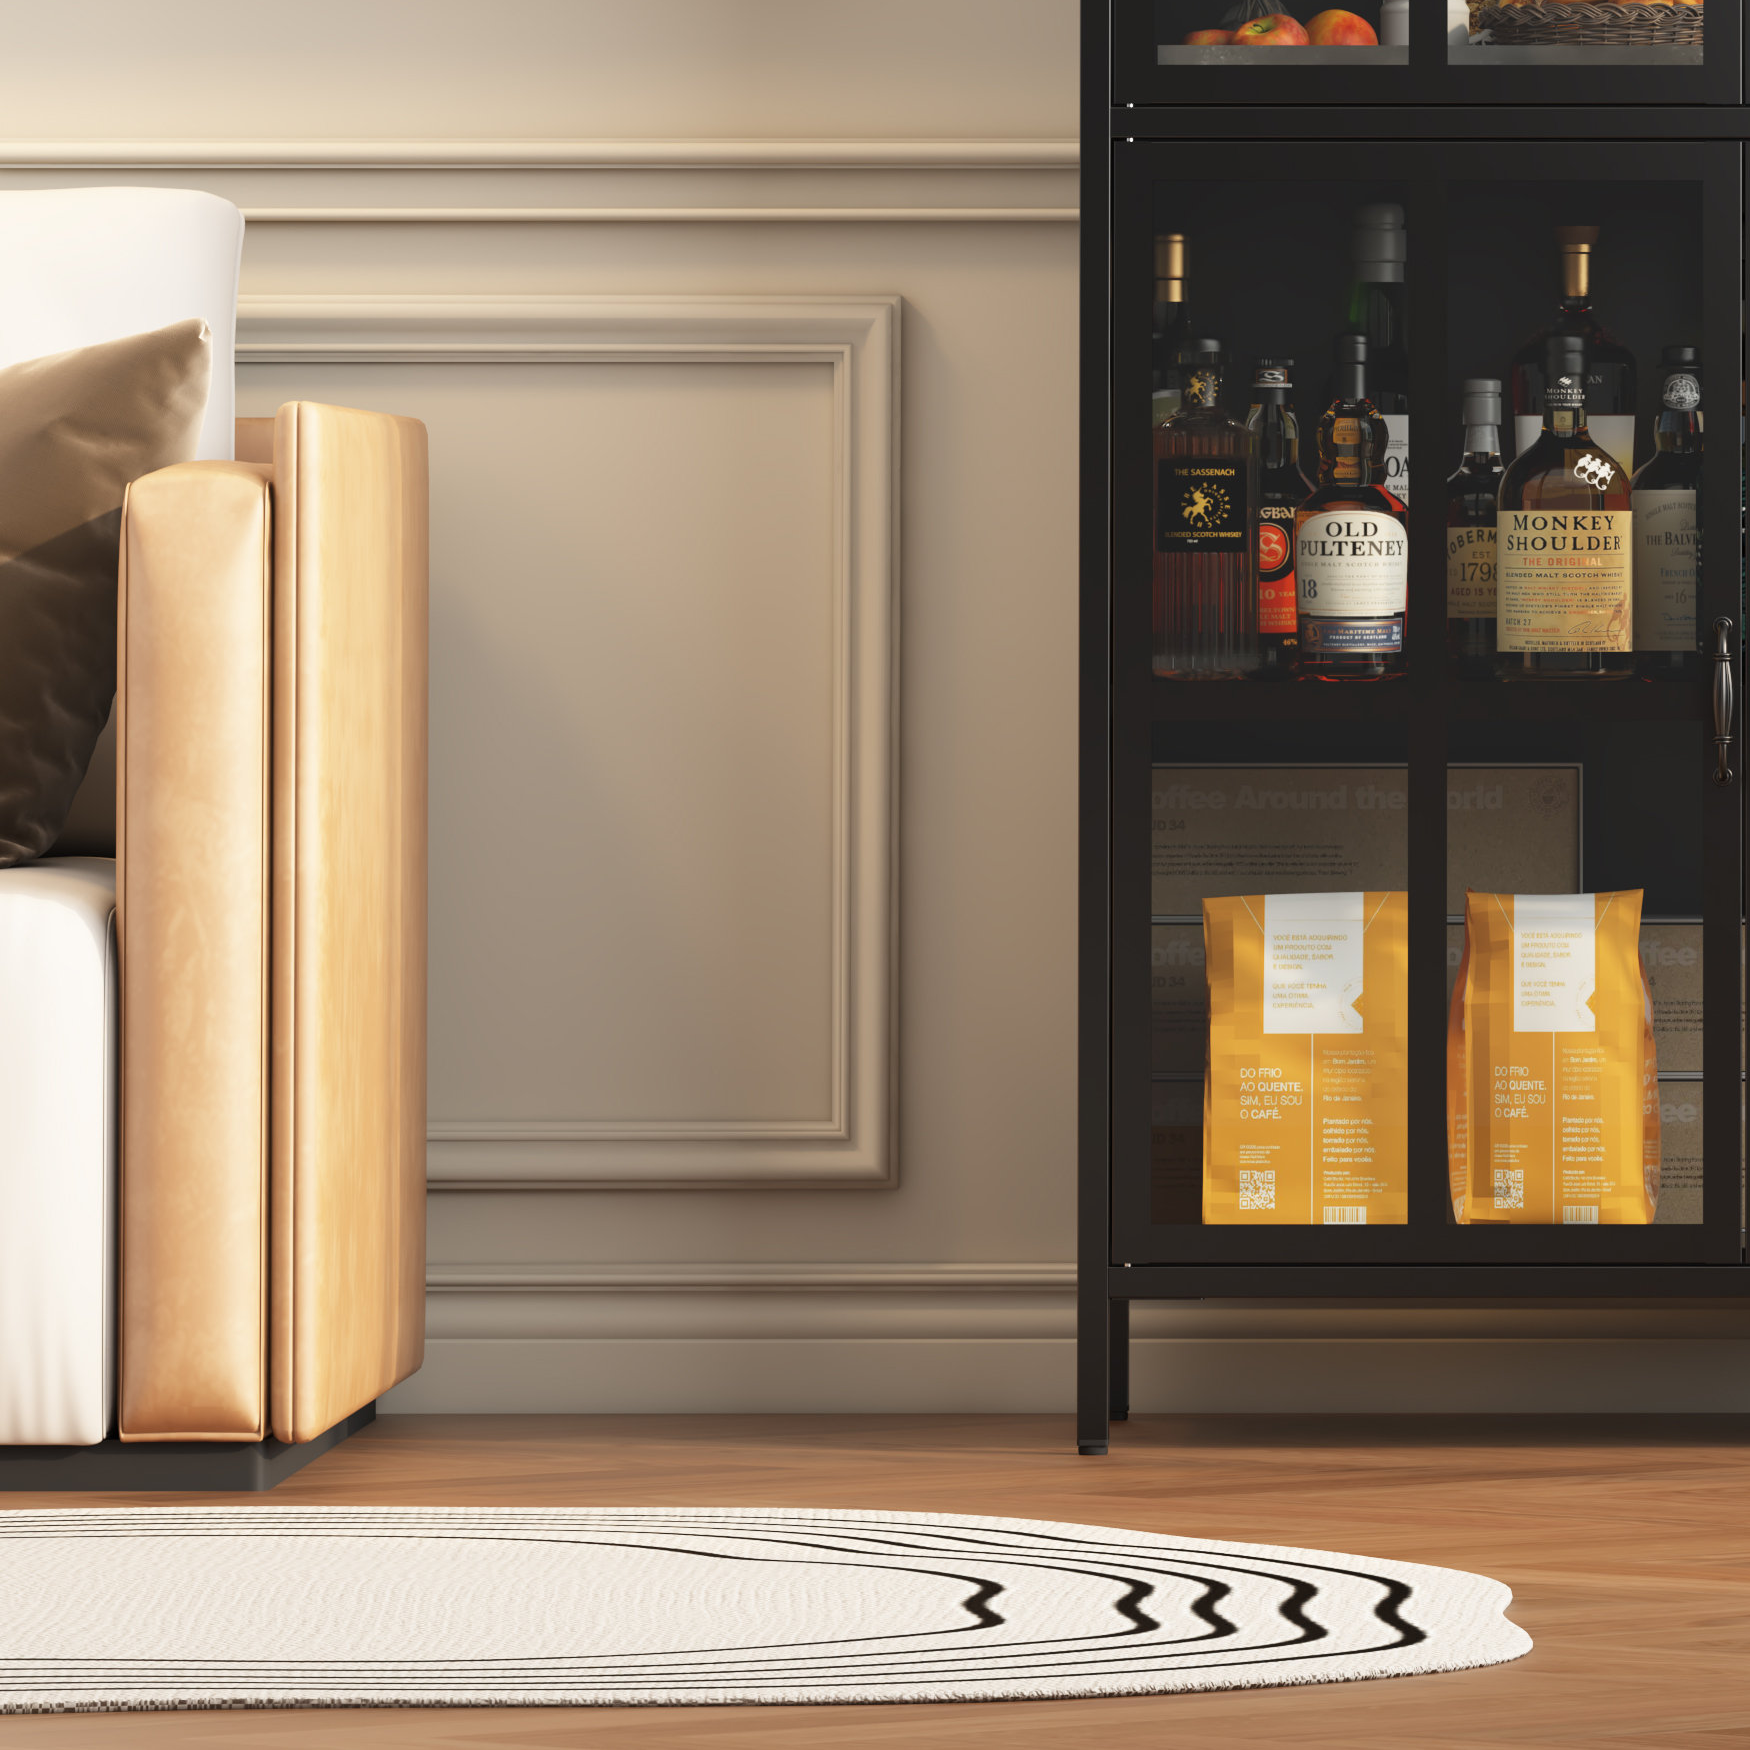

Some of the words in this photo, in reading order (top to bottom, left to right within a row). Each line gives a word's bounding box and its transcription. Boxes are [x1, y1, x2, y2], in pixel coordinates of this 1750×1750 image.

[1174, 468, 1189, 476] THE
[1190, 468, 1236, 476] SASSENACH
[1513, 515, 1614, 531] MONKEY
[1326, 521, 1378, 538] OLD
[1507, 534, 1622, 551] SHOULDER
[1646, 534, 1662, 547] THE
[1300, 540, 1404, 557] PULTENEY
[1472, 551, 1491, 559] EST
[1523, 556, 1543, 566] THE
[1547, 556, 1603, 567] ORIGINAL
[1301, 578, 1318, 599] 18
[1451, 587, 1471, 596] AGED
[1474, 587, 1484, 596] 15
[1674, 588, 1687, 604] 16
[1151, 784, 1226, 810] offee
[1233, 784, 1348, 810] Around
[1354, 784, 1408, 811] the
[1446, 784, 1504, 810] orld
[1240, 1067, 1256, 1079] DO
[1258, 1067, 1282, 1079] FRIO
[1494, 1066, 1508, 1077] DO
[1509, 1066, 1529, 1077] FRIO
[1240, 1082, 1255, 1092] AO
[1258, 1082, 1304, 1092] QUENTE.
[1494, 1080, 1507, 1091] AO
[1509, 1080, 1547, 1091] QUENTE.
[1240, 1095, 1261, 1107] SIM,
[1264, 1095, 1278, 1106] EU
[1280, 1095, 1303, 1106] SOU
[1494, 1093, 1512, 1106] SIM,
[1514, 1093, 1526, 1105] EU
[1528, 1093, 1546, 1105] SOU
[1240, 1109, 1249, 1120] O
[1251, 1106, 1282, 1120] CAFÉ.
[1494, 1107, 1502, 1119] O
[1503, 1105, 1529, 1119] CAFÉ.
[1322, 1117, 1349, 1125] Plantado
[1350, 1118, 1361, 1127] por
[1345, 1128, 1356, 1137] por
[1345, 1138, 1356, 1146] por
[1353, 1147, 1363, 1156] por
[1338, 1157, 1353, 1165] para
